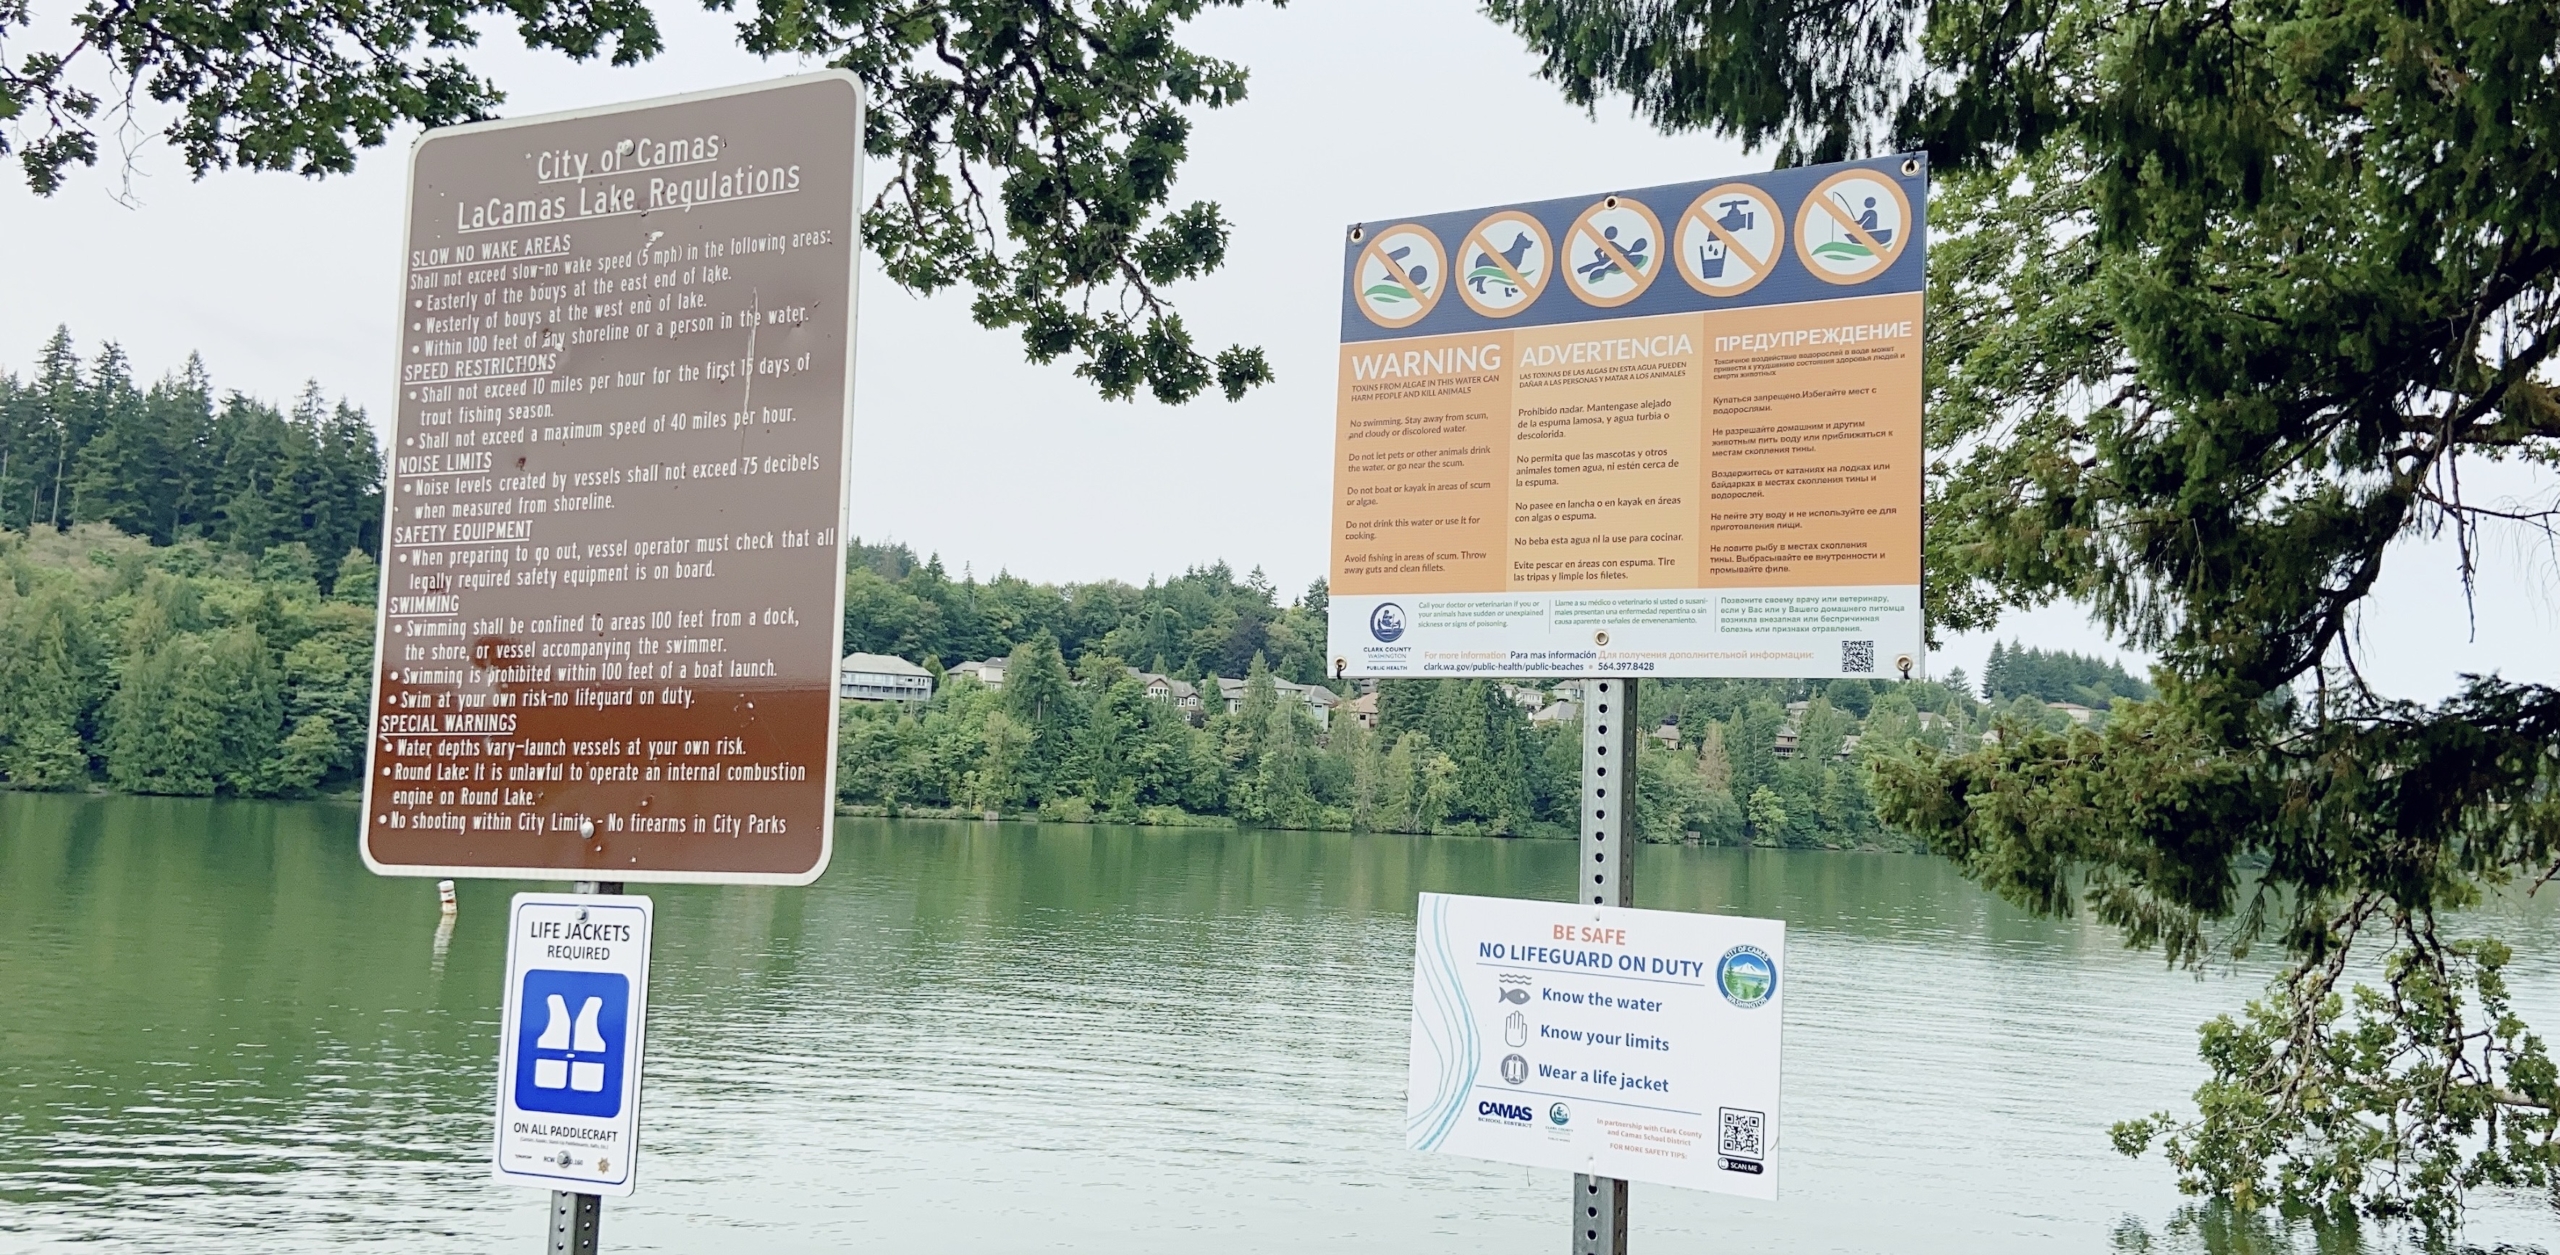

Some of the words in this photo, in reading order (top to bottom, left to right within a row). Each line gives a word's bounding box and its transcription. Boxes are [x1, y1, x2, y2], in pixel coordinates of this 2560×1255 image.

[538, 150, 588, 184] City
[601, 140, 626, 172] of
[637, 135, 719, 167] Camas
[458, 196, 565, 229] LaCamas
[580, 184, 634, 215] Lake
[650, 164, 799, 212] Regulations
[412, 247, 449, 269] SLOW
[456, 245, 474, 262] NO
[482, 240, 518, 259] WAKE
[524, 234, 570, 255] AREAS
[427, 291, 477, 311] Easterly
[484, 288, 496, 306] of
[503, 287, 523, 304] the
[530, 282, 566, 302] bouys
[573, 279, 585, 296] at
[593, 277, 613, 294] the
[620, 272, 647, 291] east
[654, 269, 676, 288] end
[683, 266, 695, 284] of
[702, 264, 731, 284] lake.
[1715, 321, 1912, 352] ПРЕДУПРЕЖДЕНИЕ
[1519, 333, 1693, 367] ADVERTENCIA
[404, 362, 448, 383] SPEED
[455, 353, 556, 377] RESTRICTIONS
[1352, 343, 1501, 380] WARNING
[1352, 383, 1378, 392] TOXINS
[1379, 382, 1401, 390] FROM
[1402, 380, 1426, 389] ALGAE
[1427, 379, 1435, 387] IN
[1437, 378, 1454, 386] THIS
[1455, 376, 1481, 385] WATER
[1482, 374, 1499, 382] CAN
[1351, 393, 1373, 402] HARM
[1374, 391, 1402, 400] PEOPLE
[1403, 390, 1420, 398] AND
[1437, 386, 1471, 395] ANIMALS
[420, 408, 452, 426] trout
[459, 405, 501, 424] fishing
[507, 404, 553, 420] season.
[1518, 406, 1557, 416] Prohibido
[1559, 405, 1584, 414] nadar.
[1586, 402, 1638, 412] Mantengase
[1640, 398, 1671, 410] alejado
[399, 454, 440, 473] NOISE
[447, 451, 492, 470] LIMITS
[1348, 453, 1360, 461] Do
[1361, 452, 1374, 460] not
[1376, 451, 1386, 459] let
[1387, 451, 1404, 461] pets
[1416, 449, 1437, 457] other
[1438, 446, 1468, 456] animals
[1470, 445, 1490, 454] drink
[1531, 513, 1552, 523] algas
[1561, 513, 1596, 521] espuma.
[394, 524, 446, 543] SAFETY
[453, 520, 532, 540] EQUIPMENT
[1514, 537, 1527, 545] No
[1528, 536, 1549, 545] beba
[1570, 537, 1590, 545] agua
[1592, 534, 1600, 543] ni
[1602, 534, 1610, 543] la
[1629, 535, 1648, 544] para
[1650, 532, 1683, 541] cocinar.
[389, 594, 459, 613] SWIMMING
[1424, 651, 1437, 659] For
[1460, 650, 1506, 659] information
[1510, 650, 1528, 659] Para
[1548, 650, 1596, 659] información
[1598, 650, 1617, 660] Для
[1618, 652, 1667, 660] получения
[1668, 650, 1747, 660] дополнительной
[1749, 650, 1814, 660] информации:
[1423, 662, 1584, 672] clark.wa.gov/public-health/public-beaches
[1598, 662, 1654, 670] 564.397.8428
[400, 690, 431, 708] Swim
[438, 691, 451, 707] at
[458, 693, 486, 710] your
[492, 693, 516, 707] own
[522, 688, 568, 706] risk-no
[575, 687, 632, 709] lifeguard
[639, 690, 654, 704] on
[662, 686, 694, 708] duty.
[381, 714, 438, 732] SPECIAL
[445, 713, 516, 731] WARNINGS
[531, 922, 560, 938] LIFE
[564, 922, 630, 942] JACKETS
[1553, 924, 1575, 941] BE
[1581, 926, 1625, 945] SAFE
[547, 945, 610, 960] REQUIRED
[1480, 942, 1505, 958] NO
[1510, 944, 1612, 968] LIFEGUARD
[1618, 954, 1645, 972] ON
[1652, 957, 1703, 977] DUTY
[1725, 946, 1737, 959] CITY
[1748, 946, 1768, 961] CAMAS
[1542, 987, 1584, 1004] Know
[1588, 992, 1612, 1007] the
[1617, 998, 1662, 1012] water
[1540, 1024, 1582, 1041] Know
[1586, 1032, 1621, 1045] your
[1625, 1032, 1669, 1051] limits
[1538, 1063, 1577, 1080] Wear
[1580, 1071, 1588, 1082] a
[1593, 1069, 1616, 1085] life
[1619, 1072, 1668, 1092] jacket
[1478, 1101, 1532, 1121] CAMAS
[513, 1122, 528, 1133] ON
[530, 1124, 547, 1135] ALL
[550, 1125, 618, 1142] PADDLECRAFT
[1478, 1116, 1502, 1125] SCHOOL
[1504, 1120, 1532, 1128] DISTRICT
[1604, 1120, 1642, 1130] partnership
[1659, 1126, 1677, 1134] Clark
[1678, 1128, 1702, 1139] County
[1620, 1130, 1642, 1139] Camas
[1643, 1133, 1665, 1142] School
[1666, 1136, 1691, 1146] District
[1609, 1142, 1623, 1150] FOR
[1624, 1145, 1643, 1153] MORE
[1644, 1147, 1669, 1156] SAFETY
[1670, 1151, 1688, 1159] TIPS:
[1730, 1162, 1746, 1171] SCAN
[1748, 1164, 1758, 1173] ME
